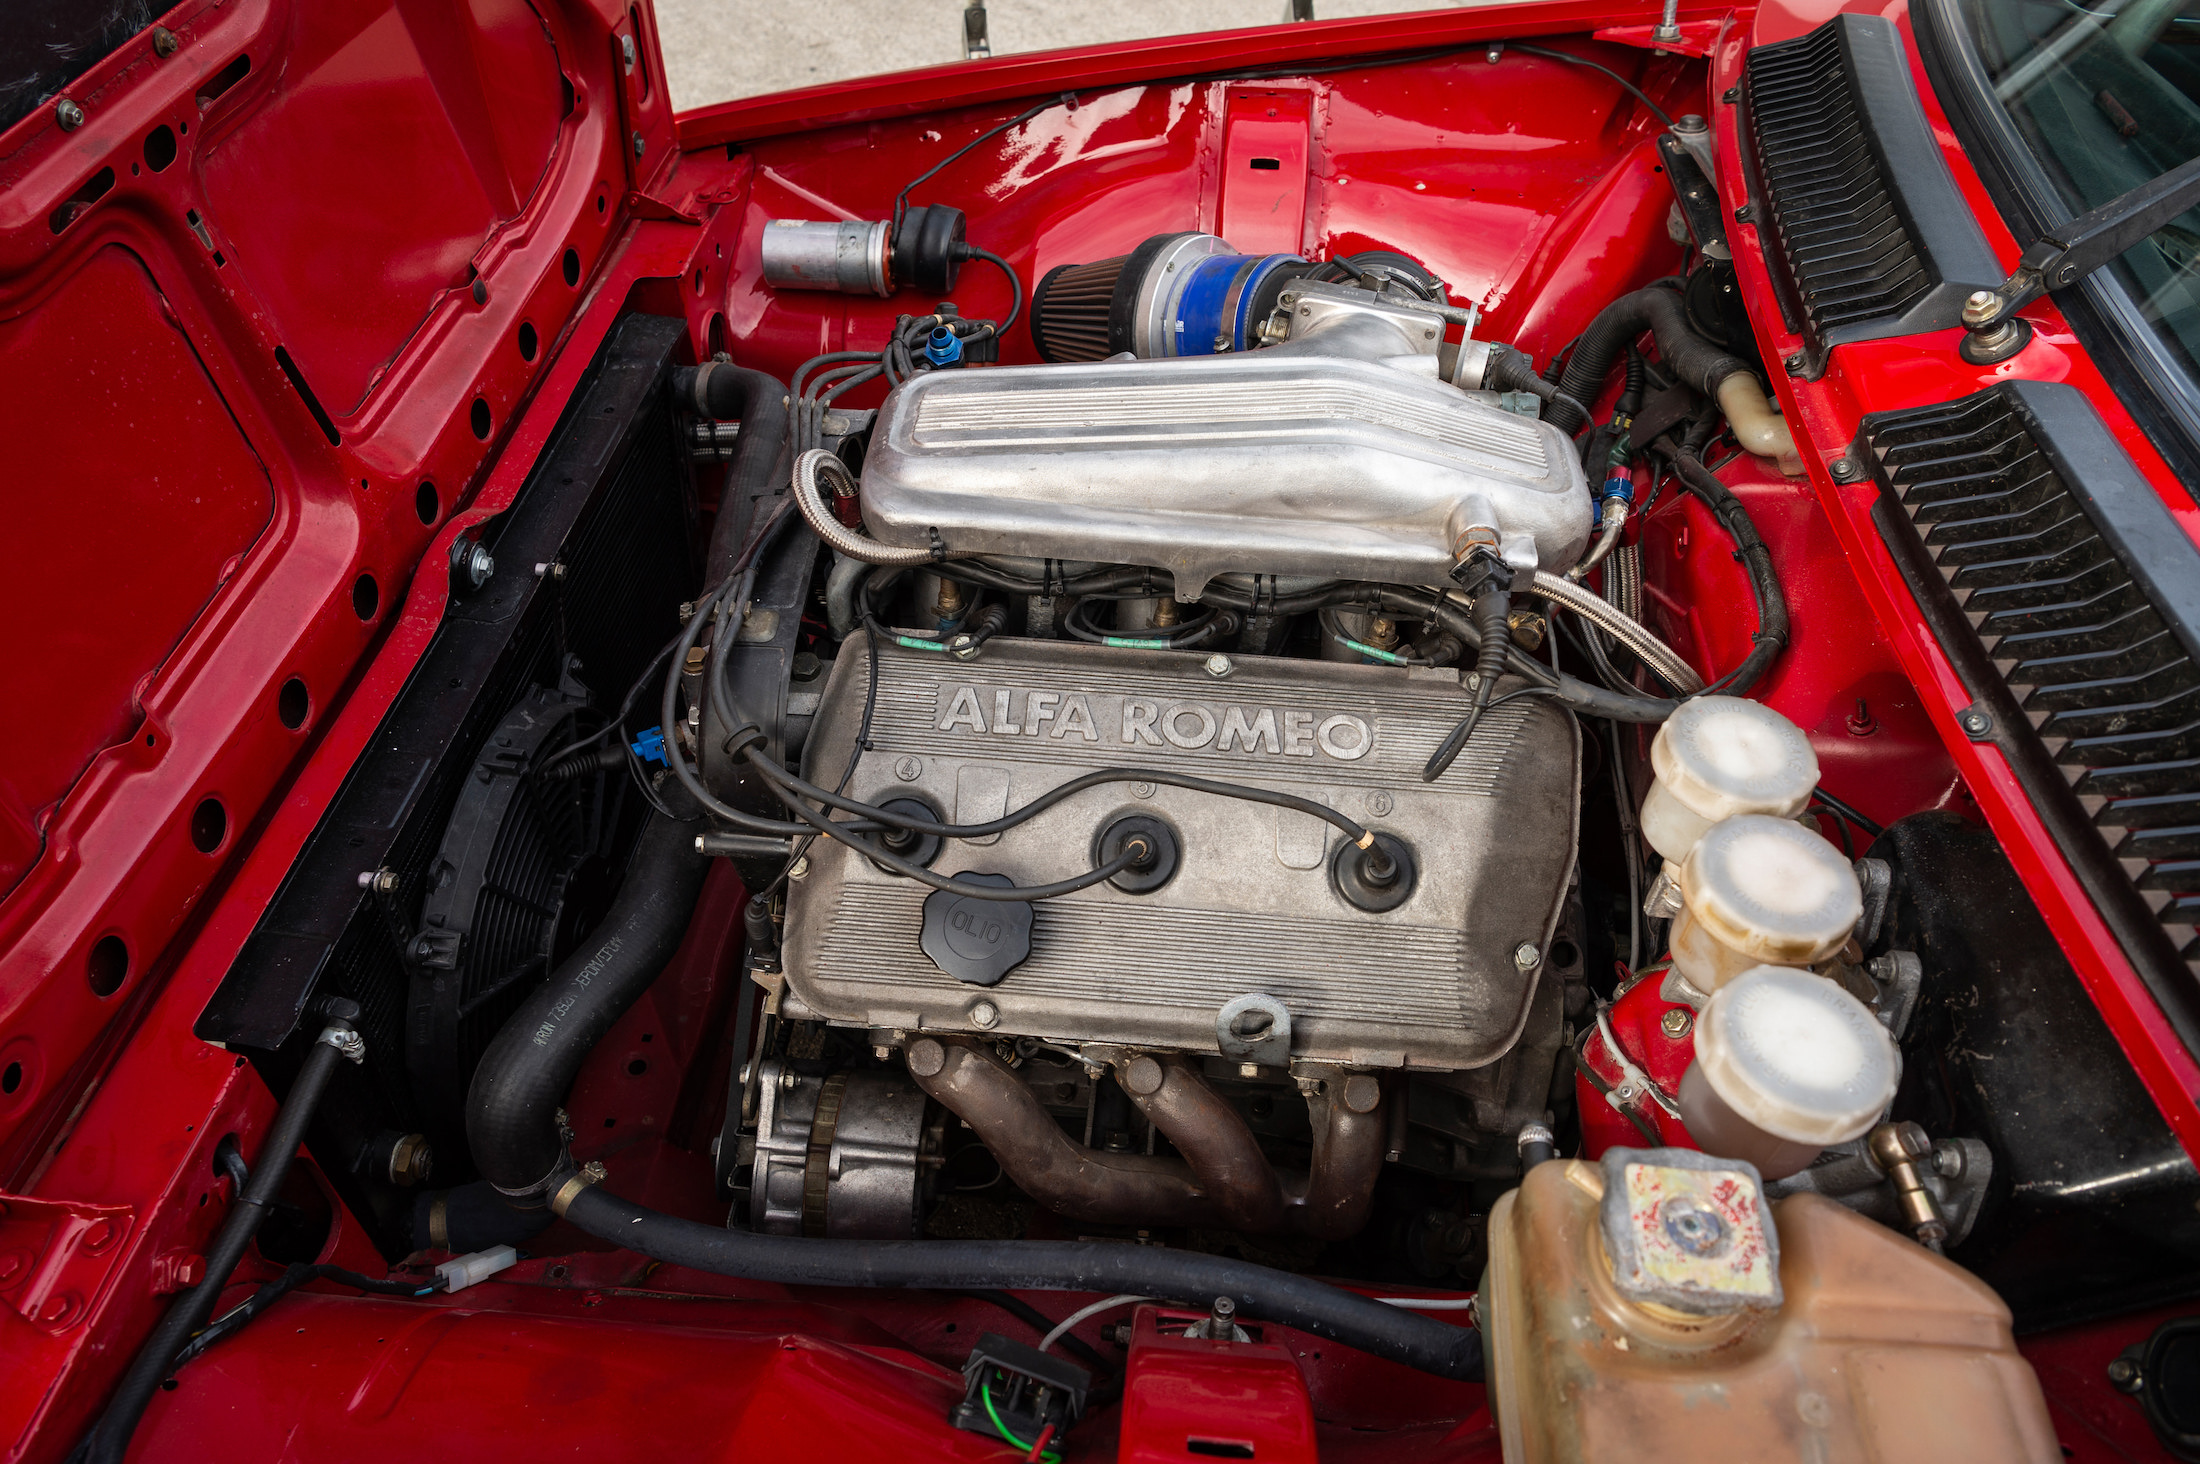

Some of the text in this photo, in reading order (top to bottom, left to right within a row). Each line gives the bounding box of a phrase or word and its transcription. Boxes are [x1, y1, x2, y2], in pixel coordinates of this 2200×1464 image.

[938, 686, 1374, 761] ALFA ROMEO
[1680, 703, 1743, 761] BRAKE FLUID
[902, 757, 914, 777] 4
[1780, 727, 1803, 772] BRAKE
[1138, 780, 1150, 795] 5
[1374, 793, 1386, 812] 6
[951, 910, 1002, 944] OLIO
[1736, 1030, 1791, 1089] BRAKE
[1820, 989, 1882, 1097] BRAKE FLUID
